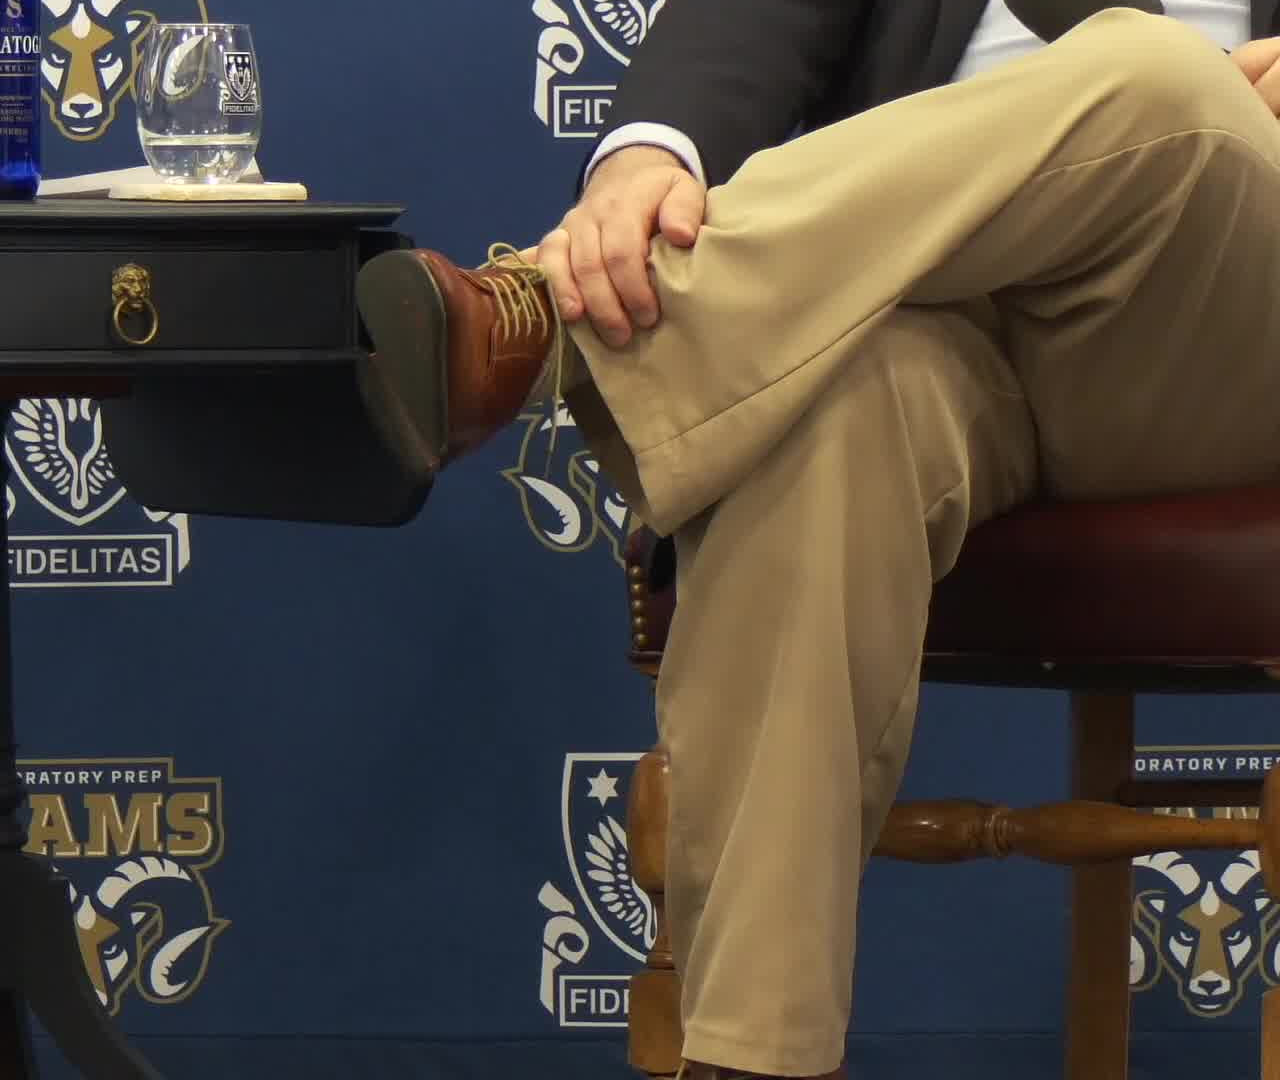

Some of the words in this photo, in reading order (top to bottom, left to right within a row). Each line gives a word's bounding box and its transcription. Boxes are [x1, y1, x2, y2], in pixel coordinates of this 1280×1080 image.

[1135, 758, 1226, 771] ORATORY
[17, 771, 102, 784] RATORY
[112, 770, 161, 783] PREP
[26, 793, 212, 856] AMS
